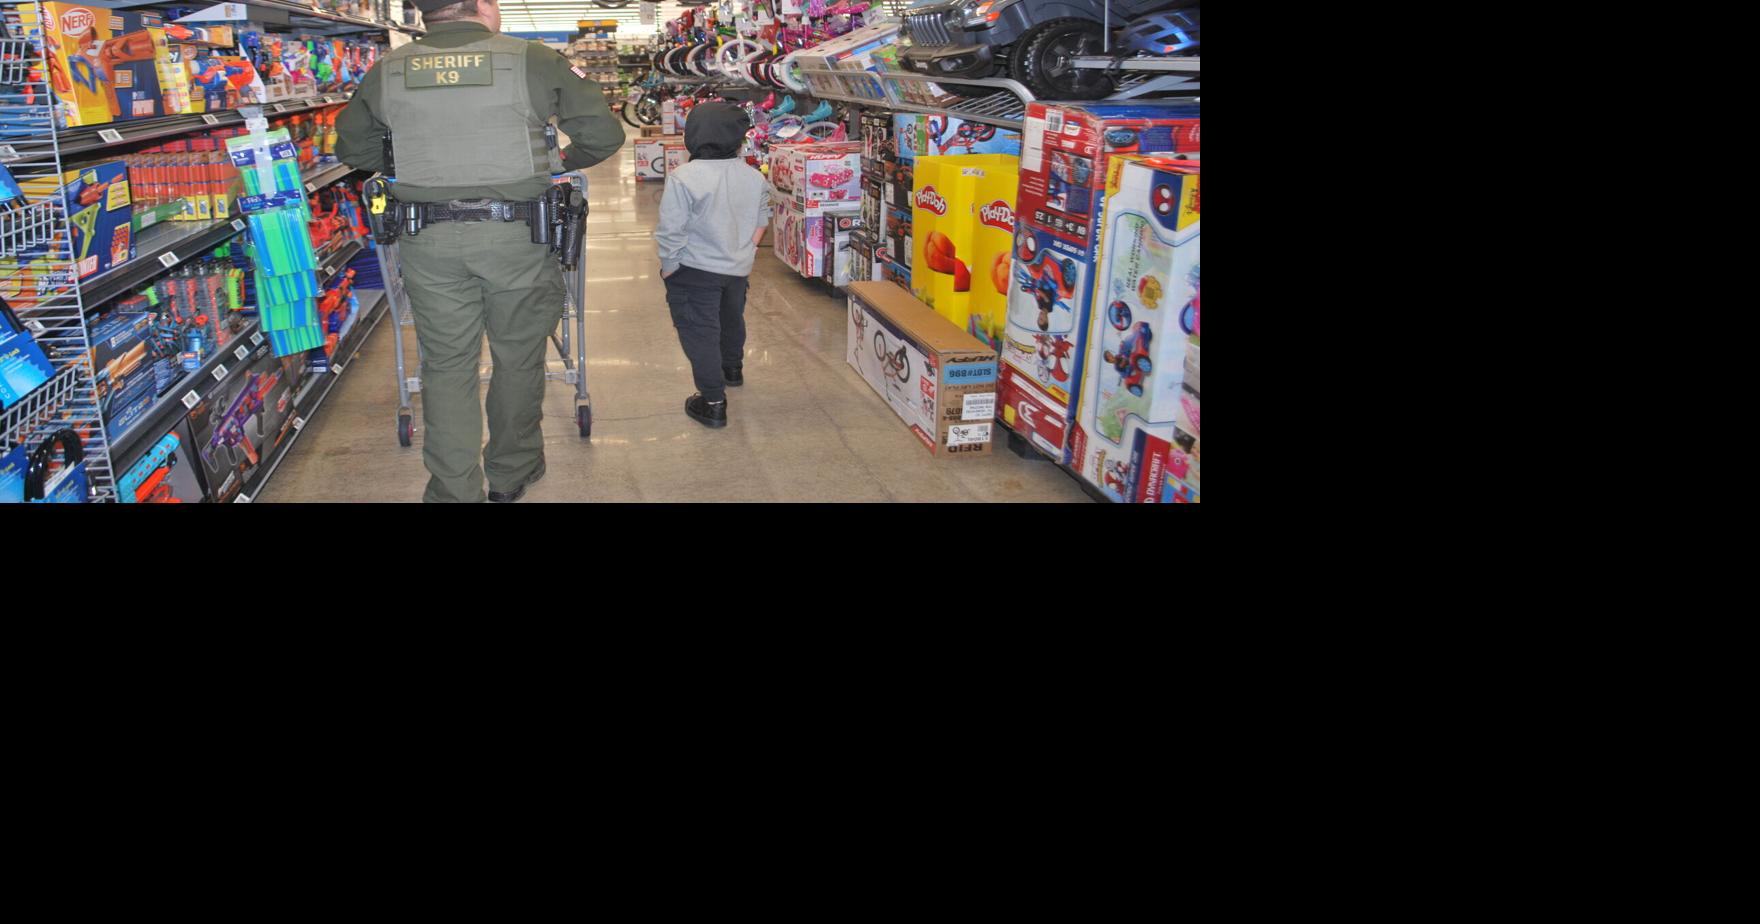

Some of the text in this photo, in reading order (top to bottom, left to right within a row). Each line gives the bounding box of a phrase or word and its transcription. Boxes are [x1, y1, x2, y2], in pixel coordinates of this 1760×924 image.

[62, 15, 93, 32] NERF
[411, 54, 485, 71] SHERIFF
[436, 71, 461, 84] K9
[981, 203, 1015, 226] Play-Do
